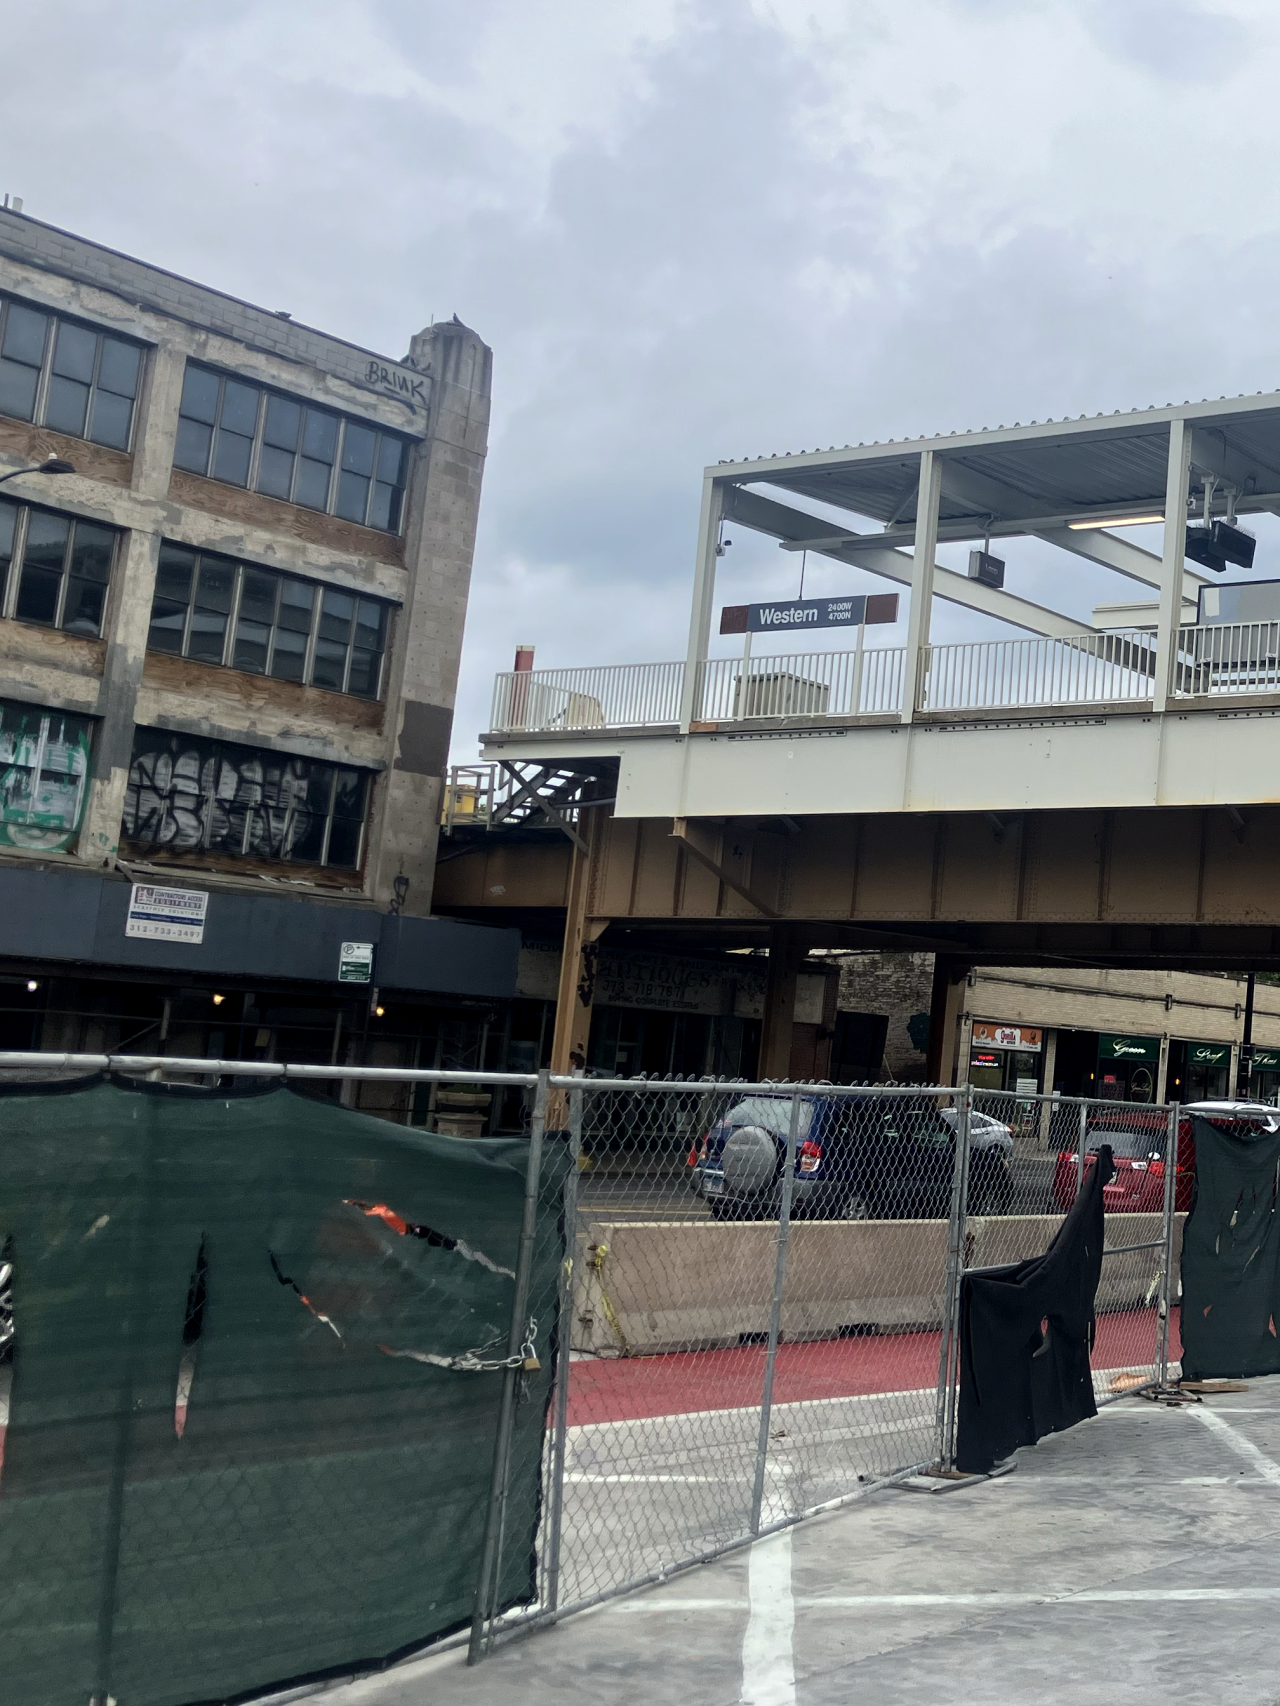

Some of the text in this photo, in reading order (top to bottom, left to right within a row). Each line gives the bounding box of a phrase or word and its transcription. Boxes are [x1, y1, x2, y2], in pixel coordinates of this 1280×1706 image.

[827, 601, 853, 612] 2400W
[759, 608, 818, 625] Western
[828, 611, 851, 620] 4700N
[1112, 1038, 1147, 1057] Green
